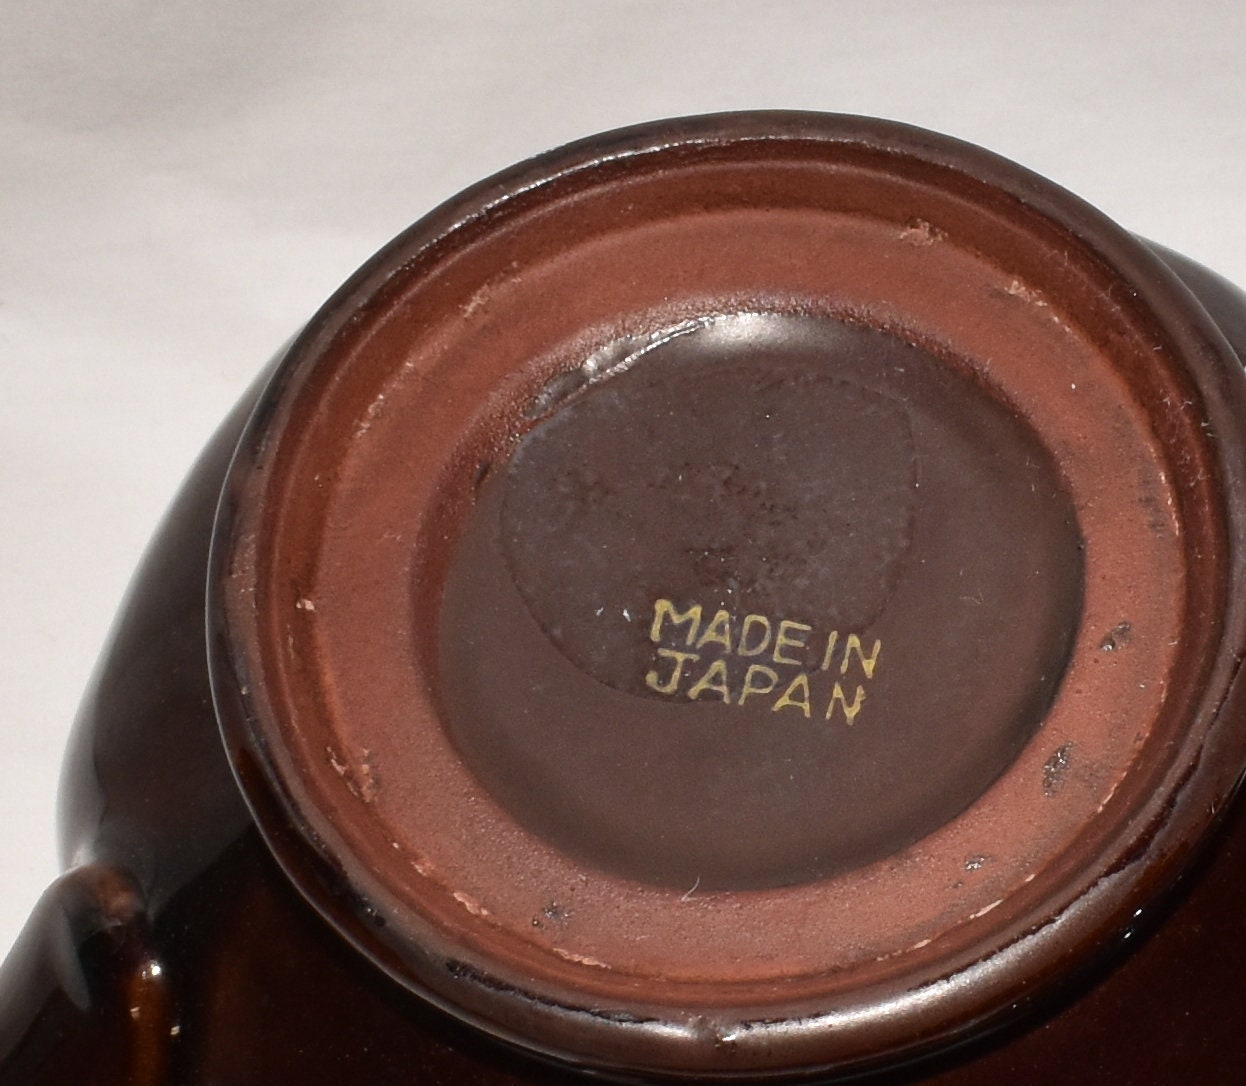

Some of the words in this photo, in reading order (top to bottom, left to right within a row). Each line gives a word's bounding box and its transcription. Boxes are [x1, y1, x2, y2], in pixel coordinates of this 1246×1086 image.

[650, 599, 812, 665] MADE
[821, 630, 882, 679] IN
[645, 648, 867, 726] JAPAN
